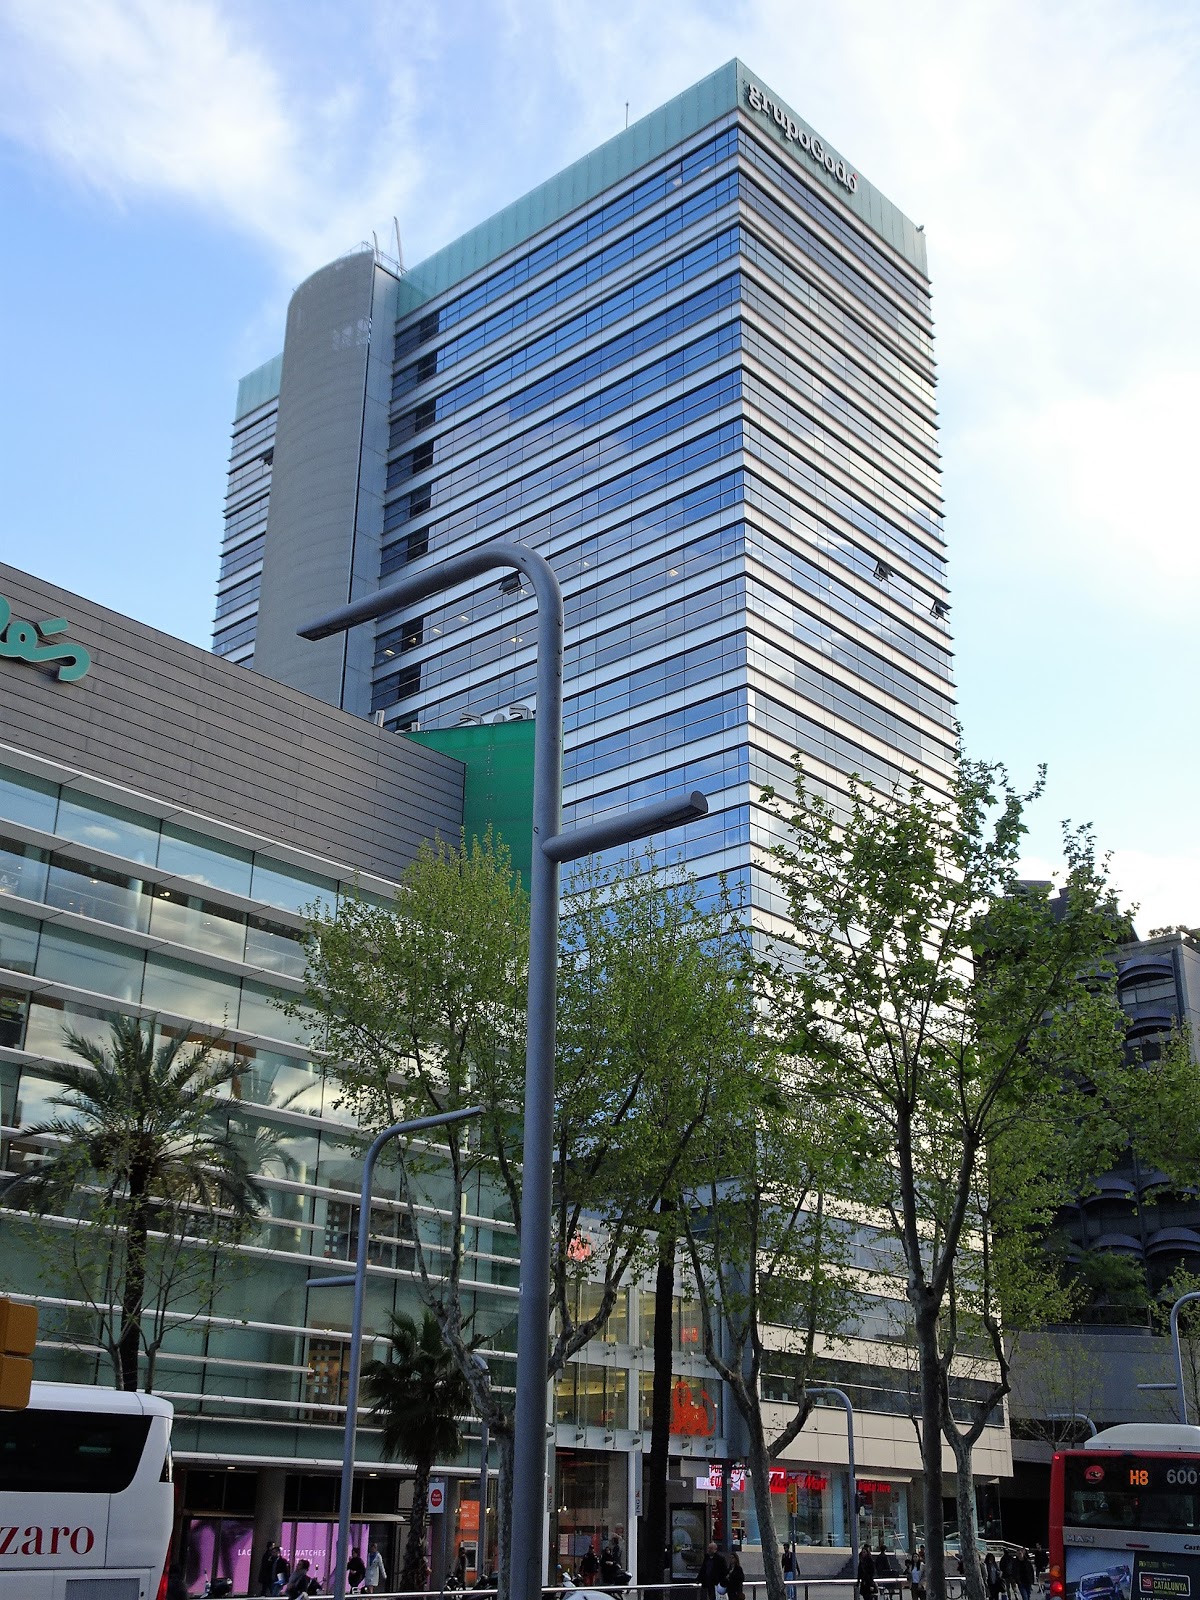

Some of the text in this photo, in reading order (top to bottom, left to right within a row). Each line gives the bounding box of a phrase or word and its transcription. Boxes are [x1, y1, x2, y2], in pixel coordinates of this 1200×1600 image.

[1129, 1469, 1149, 1486] H8
[1166, 1468, 1200, 1485] 600
[1153, 1580, 1187, 1592] CATALUNYA
